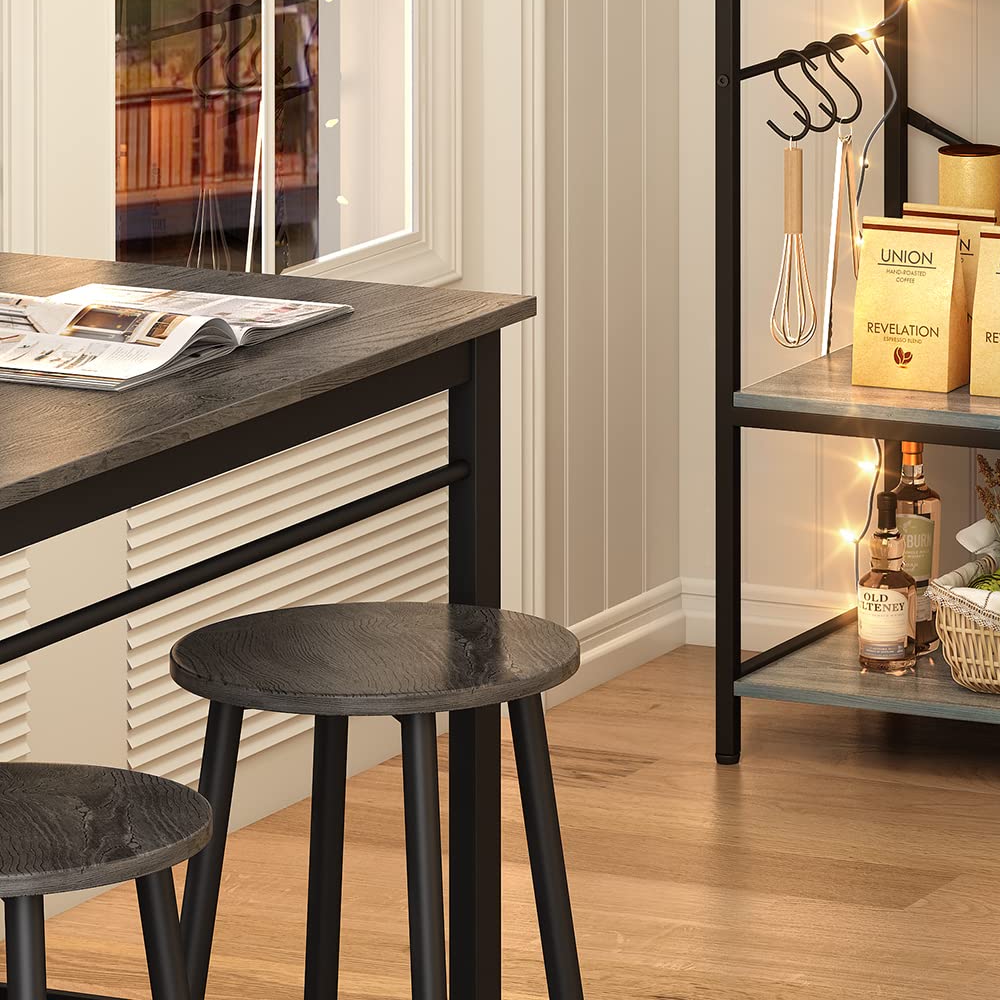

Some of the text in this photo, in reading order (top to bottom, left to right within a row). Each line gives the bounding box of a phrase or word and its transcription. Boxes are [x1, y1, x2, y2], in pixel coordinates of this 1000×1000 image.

[881, 248, 933, 265] UNION
[886, 269, 927, 277] HAND-ROASTED
[867, 322, 940, 338] REVELATION
[883, 336, 907, 344] ESPRESSO
[863, 592, 888, 603] OLD
